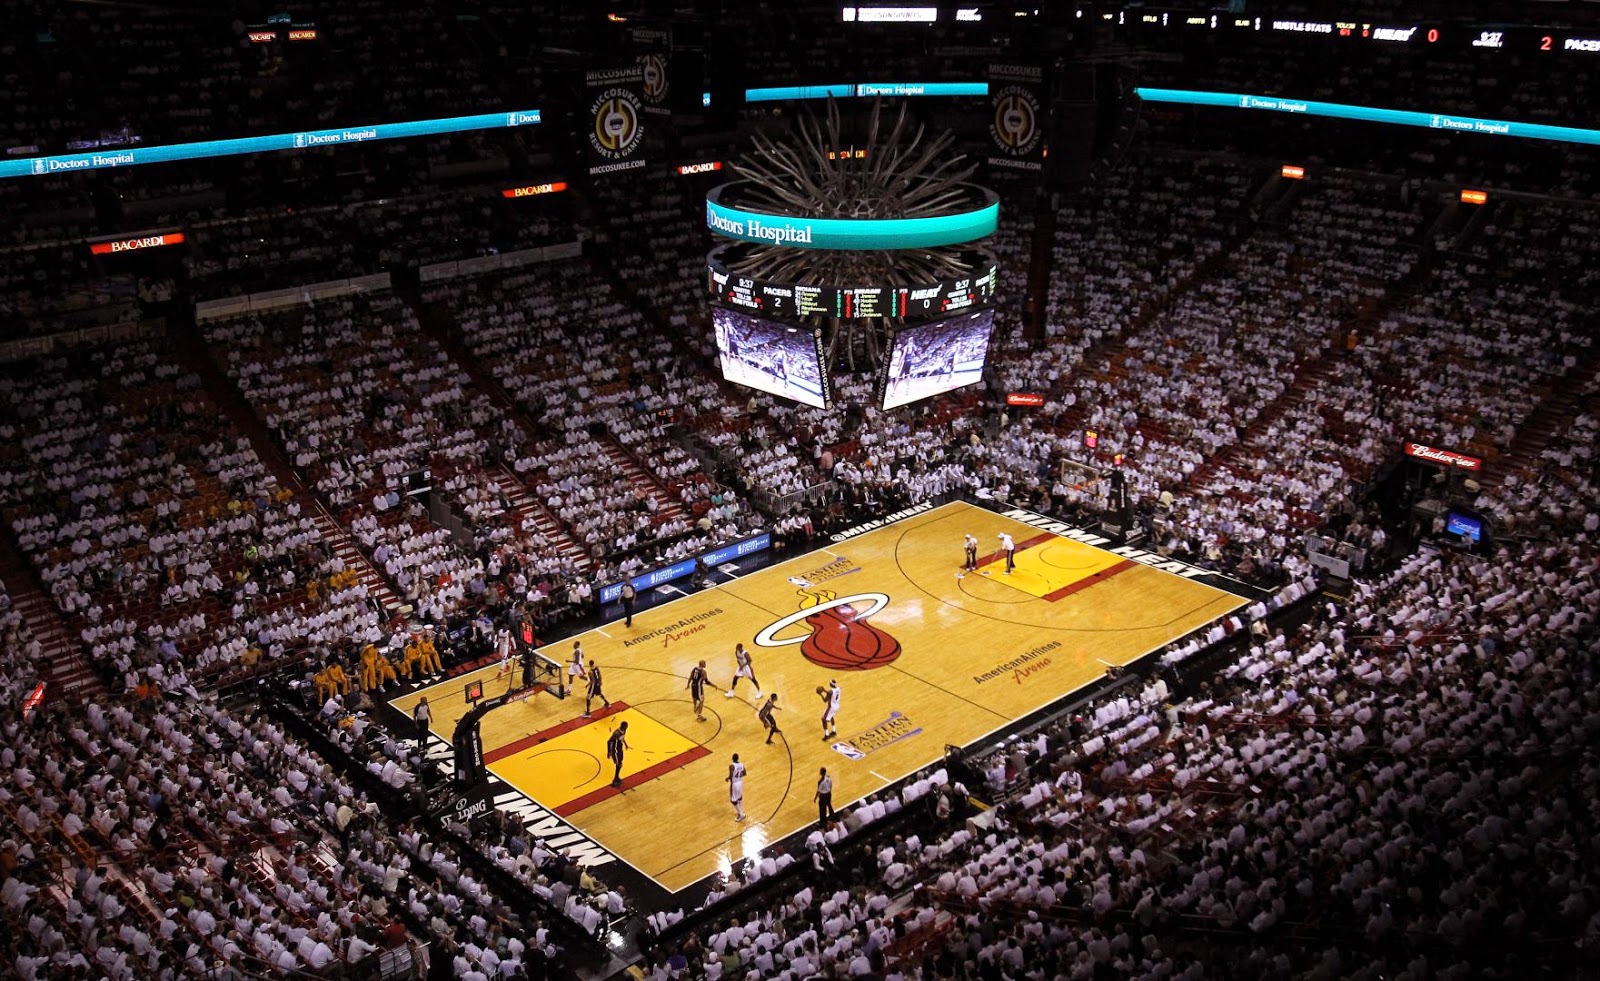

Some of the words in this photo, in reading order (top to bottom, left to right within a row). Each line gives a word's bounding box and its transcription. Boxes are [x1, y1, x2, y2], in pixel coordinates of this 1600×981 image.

[1273, 21, 1304, 32] HUSTLE
[1305, 22, 1332, 33] STATS
[1373, 26, 1417, 42] HEAT
[1428, 29, 1438, 42] 0
[1541, 36, 1552, 50] 2
[586, 67, 643, 80] MICCOSUKEE
[895, 85, 924, 95] Hospital
[591, 88, 642, 115] MICCOSUKEE
[1251, 98, 1277, 109] Doctors
[1278, 100, 1307, 113] Hospital
[1443, 118, 1473, 131] Doctors
[1475, 120, 1509, 134] Hospital
[308, 133, 340, 145] Doctors
[342, 129, 377, 143] Hospital
[589, 132, 611, 158] RESORT
[622, 126, 644, 157] GAMING
[50, 159, 90, 171] Doctors
[92, 152, 135, 167] Hospital
[829, 150, 865, 160] BCADI
[589, 159, 646, 175] MICCOSUKEE.COM
[681, 162, 715, 175] BACARDI
[514, 184, 552, 197] BACARDI
[711, 209, 744, 236] Doctors
[747, 219, 812, 245] Hospital
[111, 236, 164, 252] BACARDI
[739, 278, 754, 288] 9:37
[955, 280, 969, 290] 9:37
[763, 286, 792, 297] PACERS
[910, 284, 943, 300] HEAT
[774, 298, 782, 308] 2
[923, 300, 930, 308] 0
[816, 337, 831, 401] MICCOSUKEE.COM
[877, 338, 893, 402] MICCOSUKEE.COM
[1001, 509, 1111, 546] MIAMI
[1109, 546, 1223, 578] HEAT
[801, 559, 854, 581] EASTERN
[624, 607, 723, 648] AmericanAirlines
[662, 623, 707, 648] Arena
[973, 640, 1062, 684] AmericanAirlines
[1012, 657, 1052, 685] Arena
[849, 715, 911, 749] EASTERN
[440, 799, 486, 830] SPLDING
[493, 790, 617, 868] MIAMI
